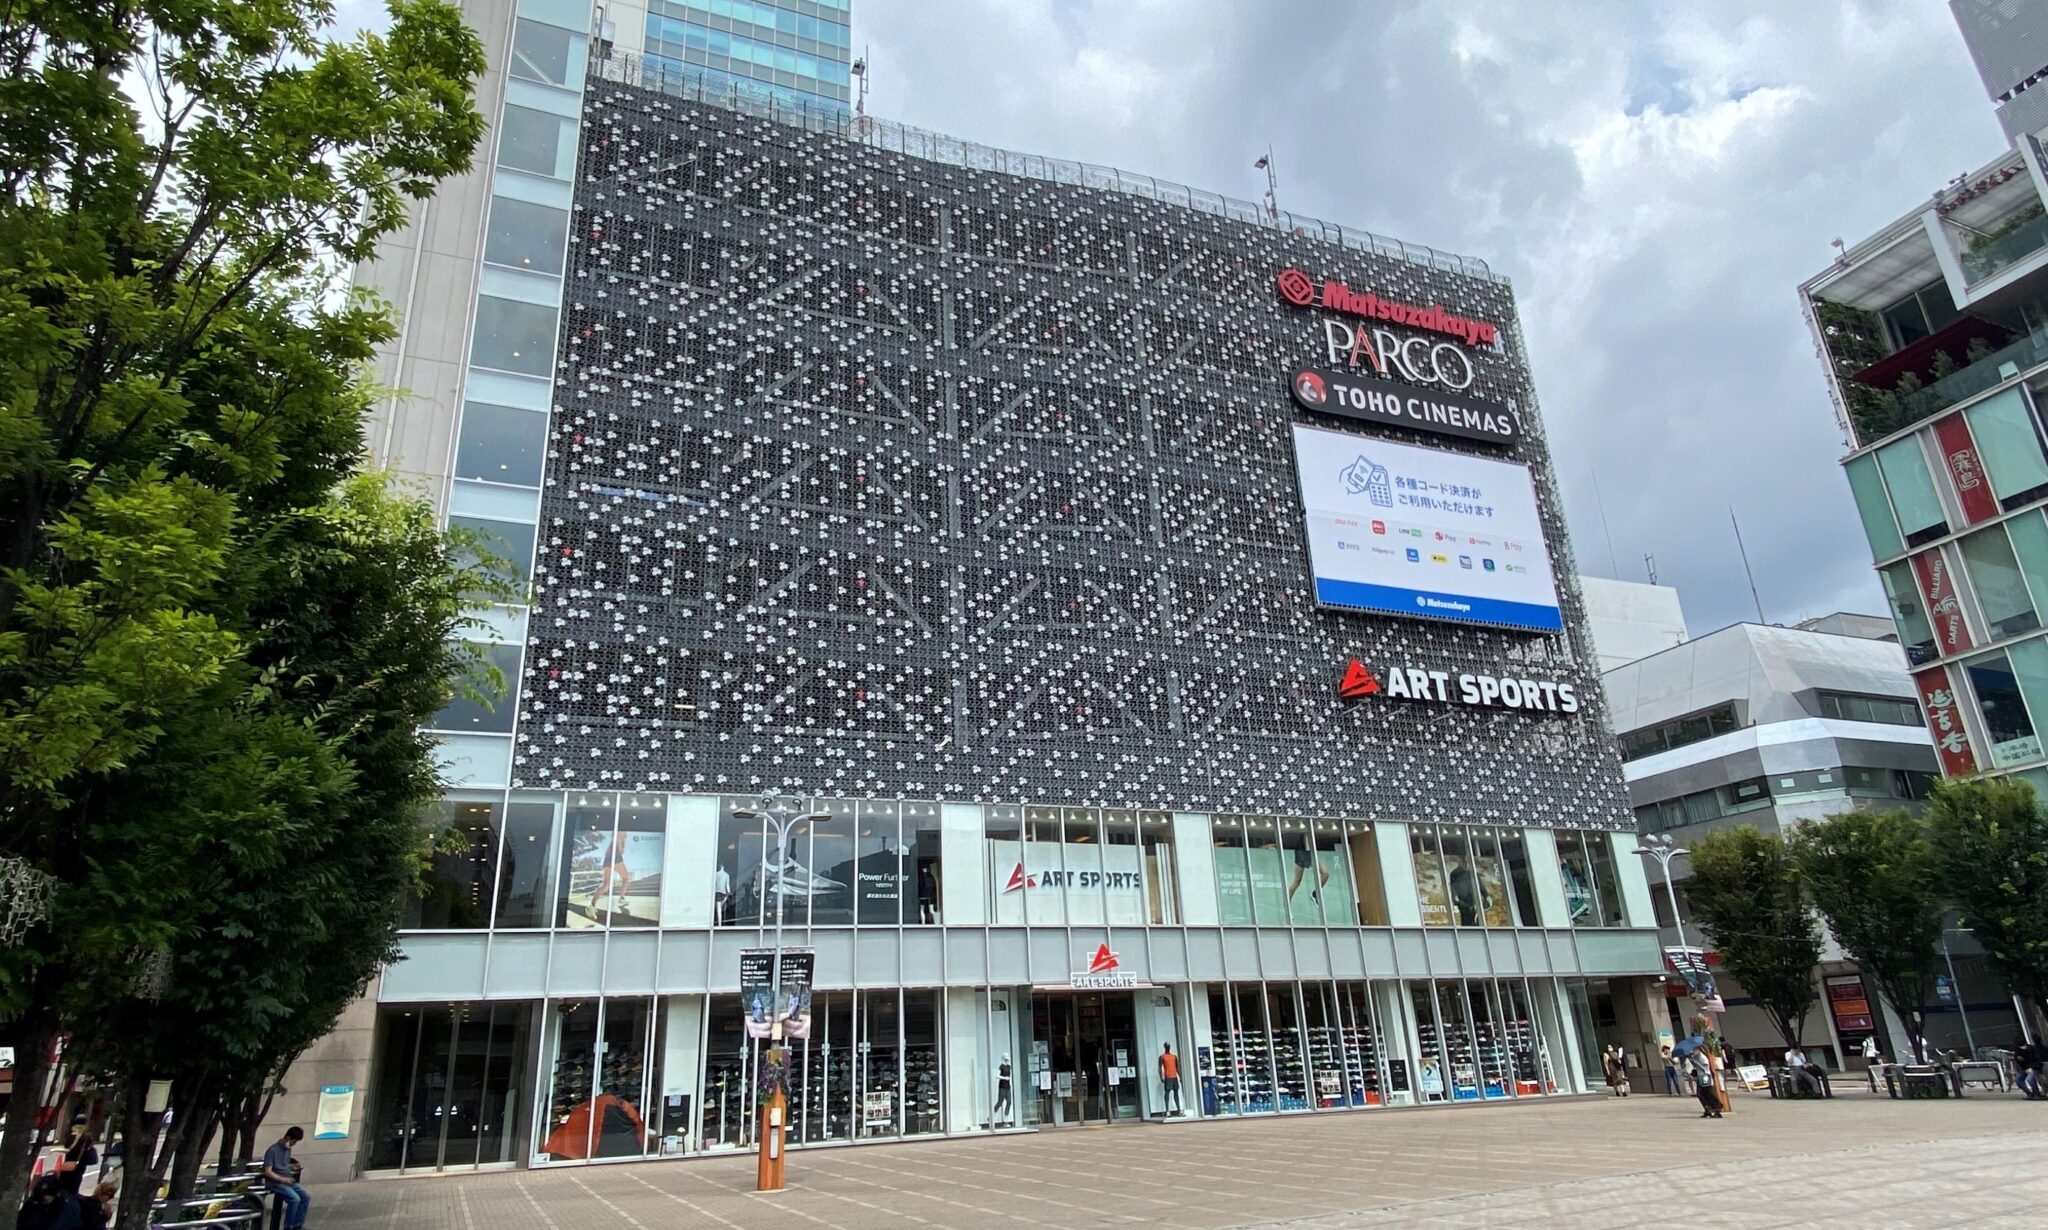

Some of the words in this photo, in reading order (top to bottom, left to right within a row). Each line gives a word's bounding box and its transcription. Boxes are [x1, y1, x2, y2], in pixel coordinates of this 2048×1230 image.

[1322, 281, 1495, 346] Matsuzakaya
[1323, 319, 1473, 389] PARCO
[1332, 384, 1402, 417] TOHO
[1407, 398, 1512, 436] CINEMAS
[1395, 476, 1482, 499] 各種コード決済が
[1398, 493, 1494, 517] ご利用いただけます
[1931, 559, 1943, 600] BILLIARD
[1947, 614, 1959, 645] DARTS
[1387, 666, 1449, 702] ART
[1459, 674, 1578, 713] SPORTS
[859, 872, 883, 882] Power
[1077, 975, 1096, 988] ART
[1097, 975, 1135, 988] SPORTS
